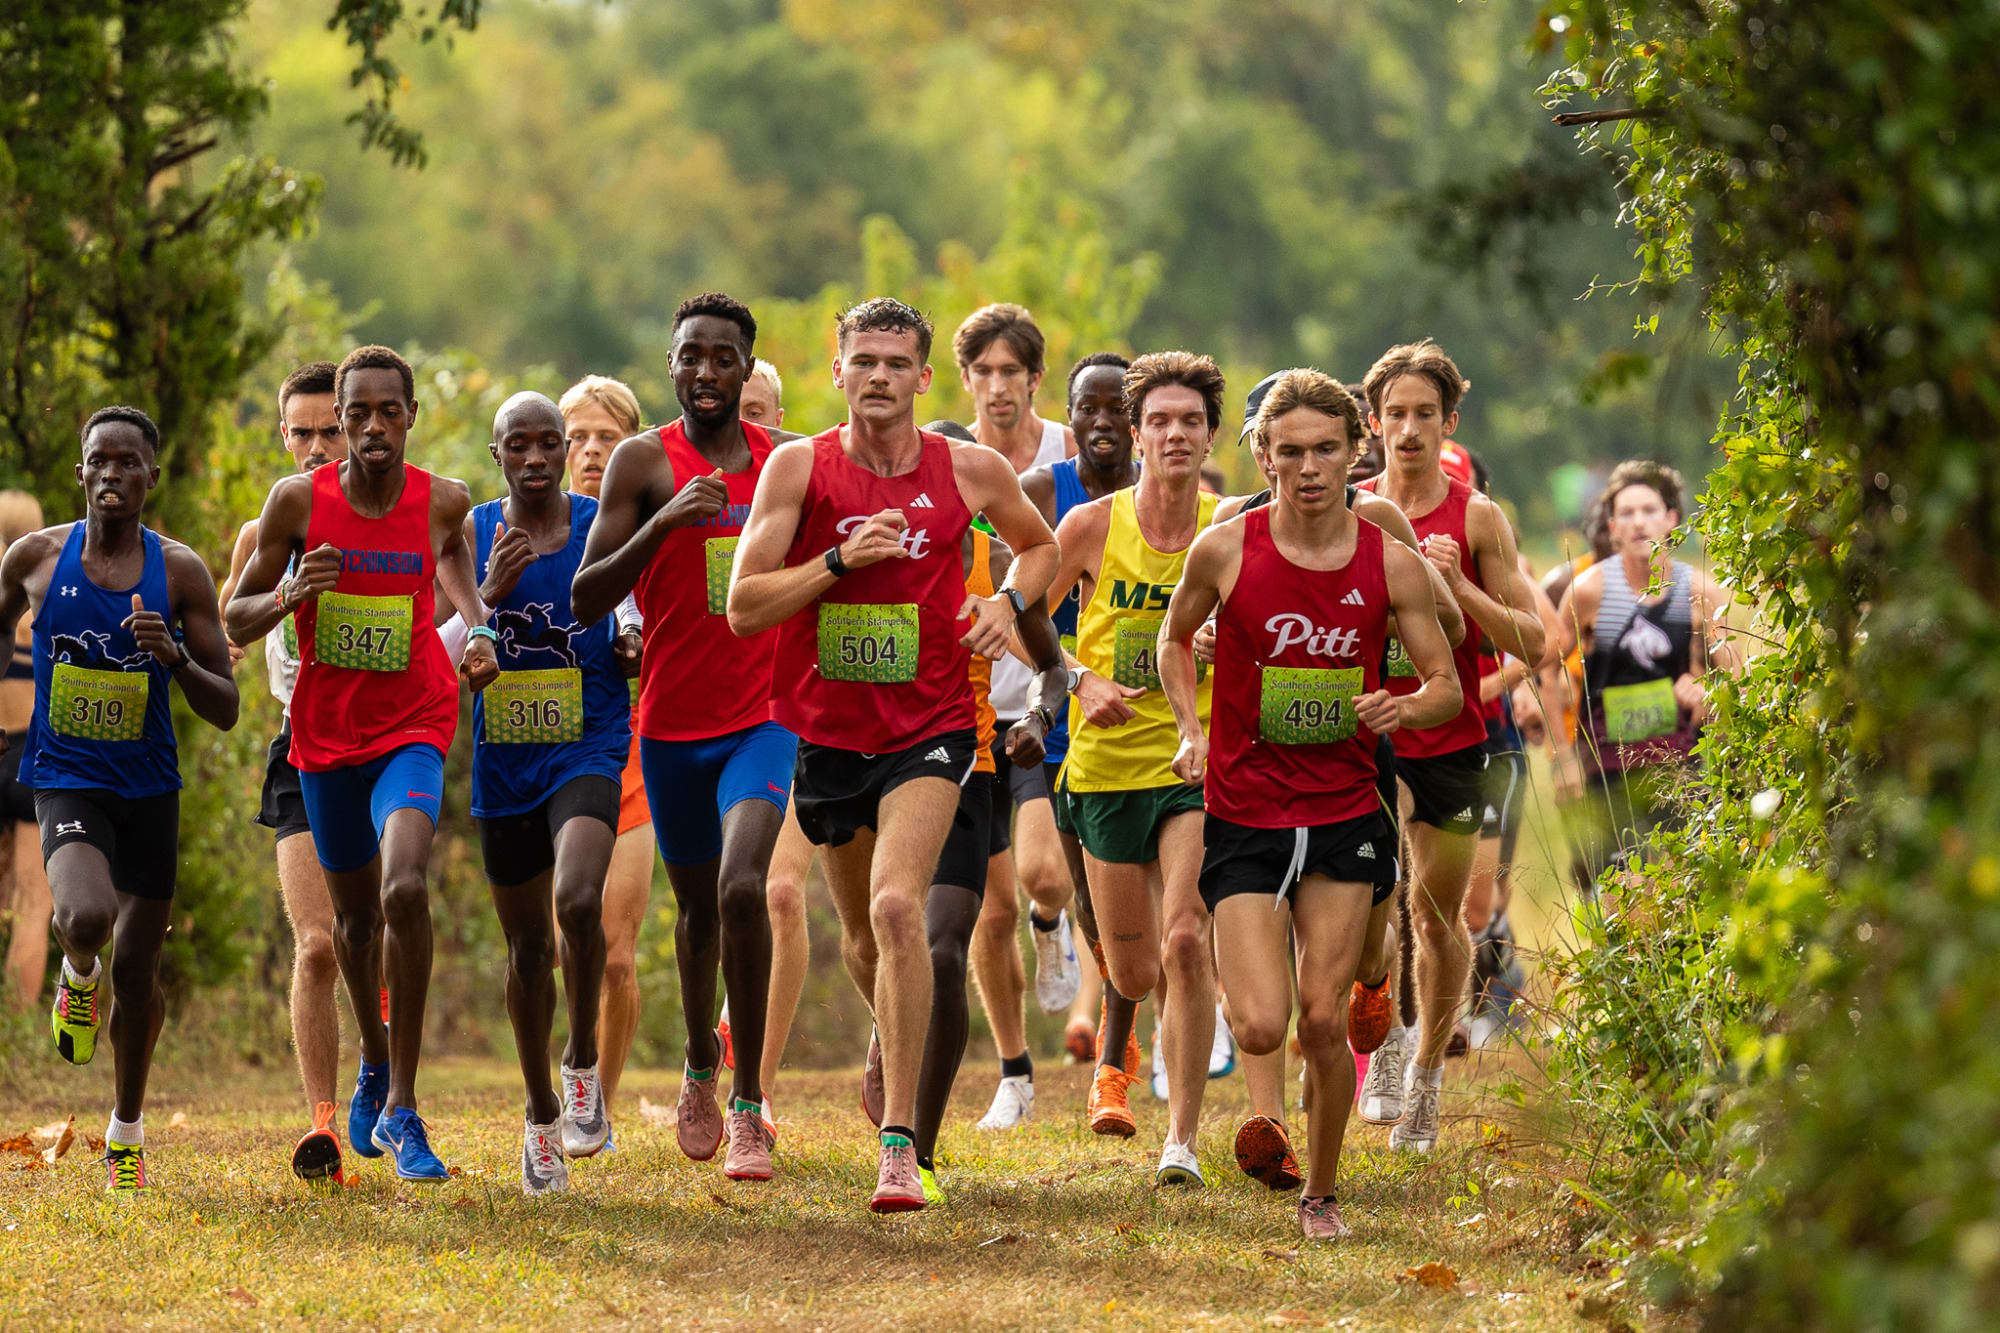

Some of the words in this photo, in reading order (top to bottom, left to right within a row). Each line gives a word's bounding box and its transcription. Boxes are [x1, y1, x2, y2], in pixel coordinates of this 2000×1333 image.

[836, 515, 930, 560] Ptt
[325, 549, 423, 576] TCHINSON
[715, 550, 736, 559] Sout
[1109, 579, 1177, 610] MS
[325, 602, 362, 616] Southern
[364, 608, 406, 618] Stampede
[826, 616, 865, 626] Southern
[867, 617, 911, 627] Stampede
[337, 623, 393, 655] 347
[1264, 612, 1361, 658] Pitt
[840, 634, 899, 667] 504
[60, 674, 98, 689] Southern
[99, 681, 142, 693] Stampede
[492, 681, 530, 691] Southern
[532, 680, 574, 691] Stampede
[1271, 680, 1312, 690] Southern
[1314, 680, 1356, 690] Stampede
[71, 695, 124, 727] 319
[508, 698, 562, 728] 316
[1283, 698, 1342, 728] 494
